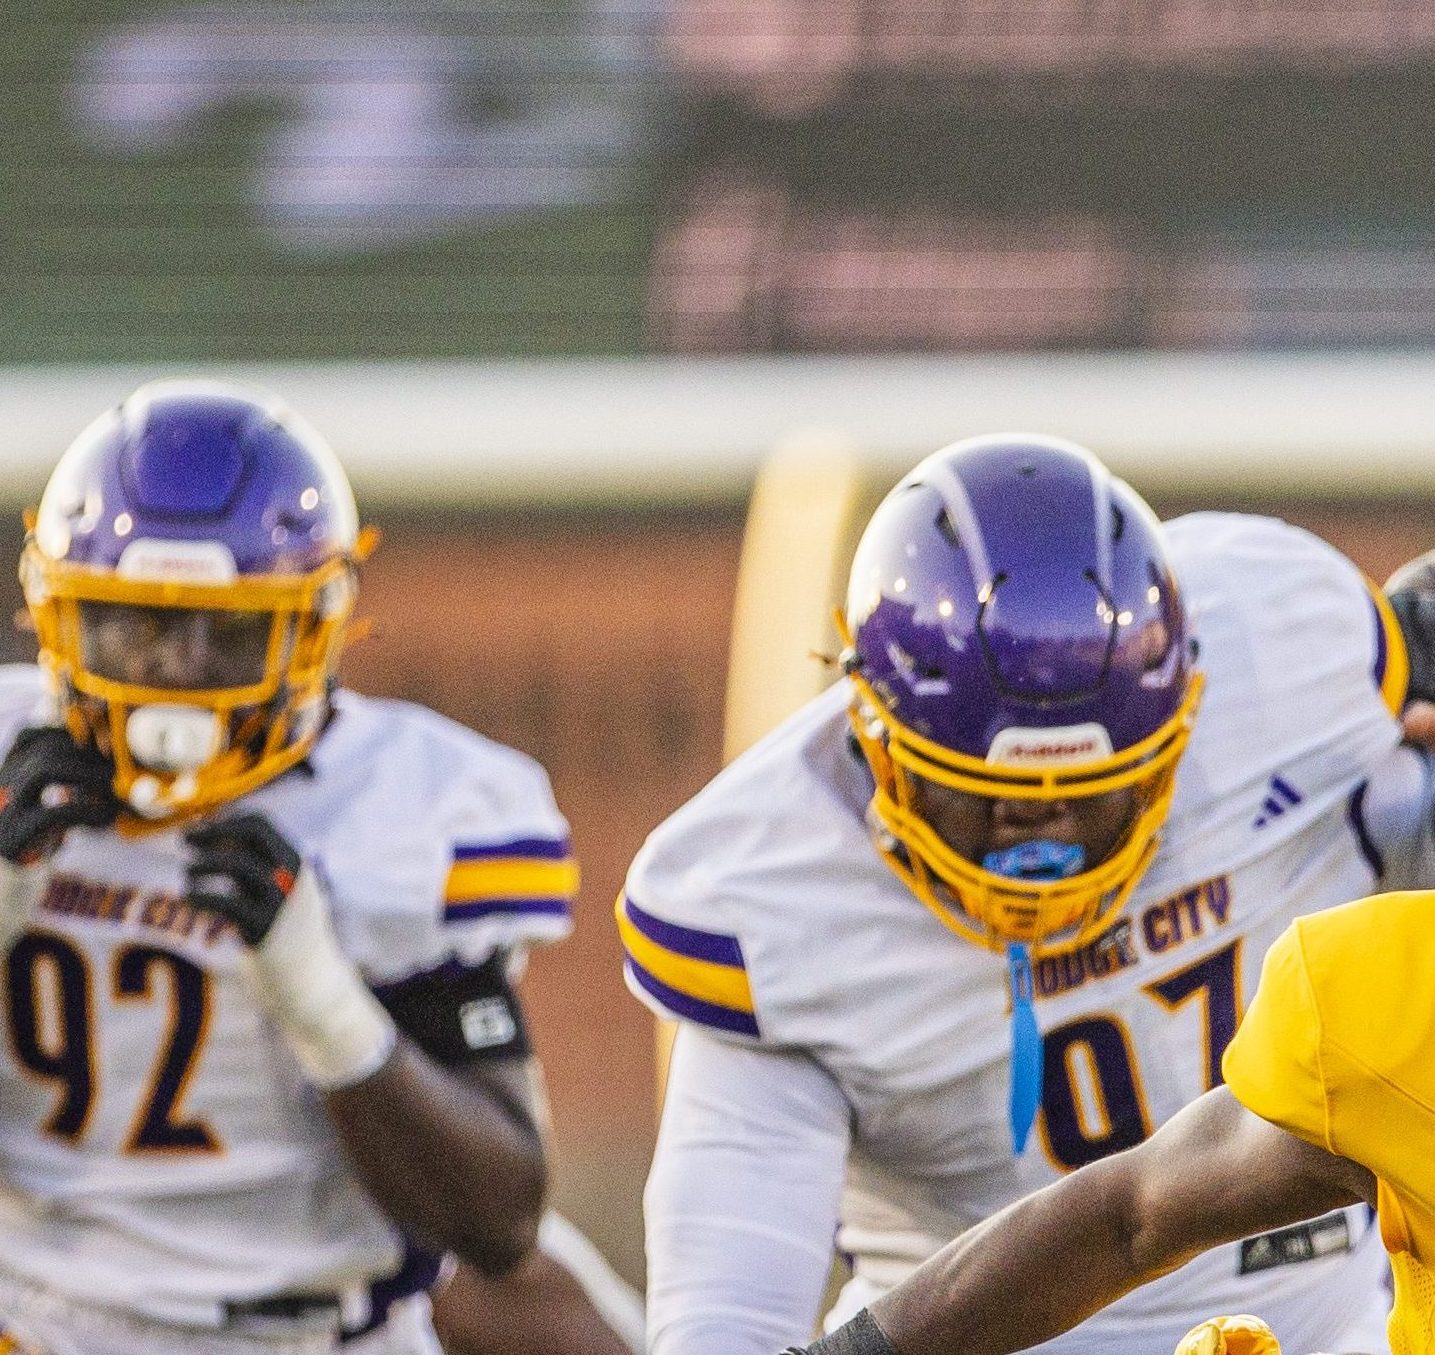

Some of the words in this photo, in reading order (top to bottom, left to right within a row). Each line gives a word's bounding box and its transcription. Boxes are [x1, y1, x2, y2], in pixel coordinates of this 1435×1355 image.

[1034, 917, 1139, 999] ODGE
[1142, 874, 1233, 952] CITY
[2, 923, 228, 1158] 92
